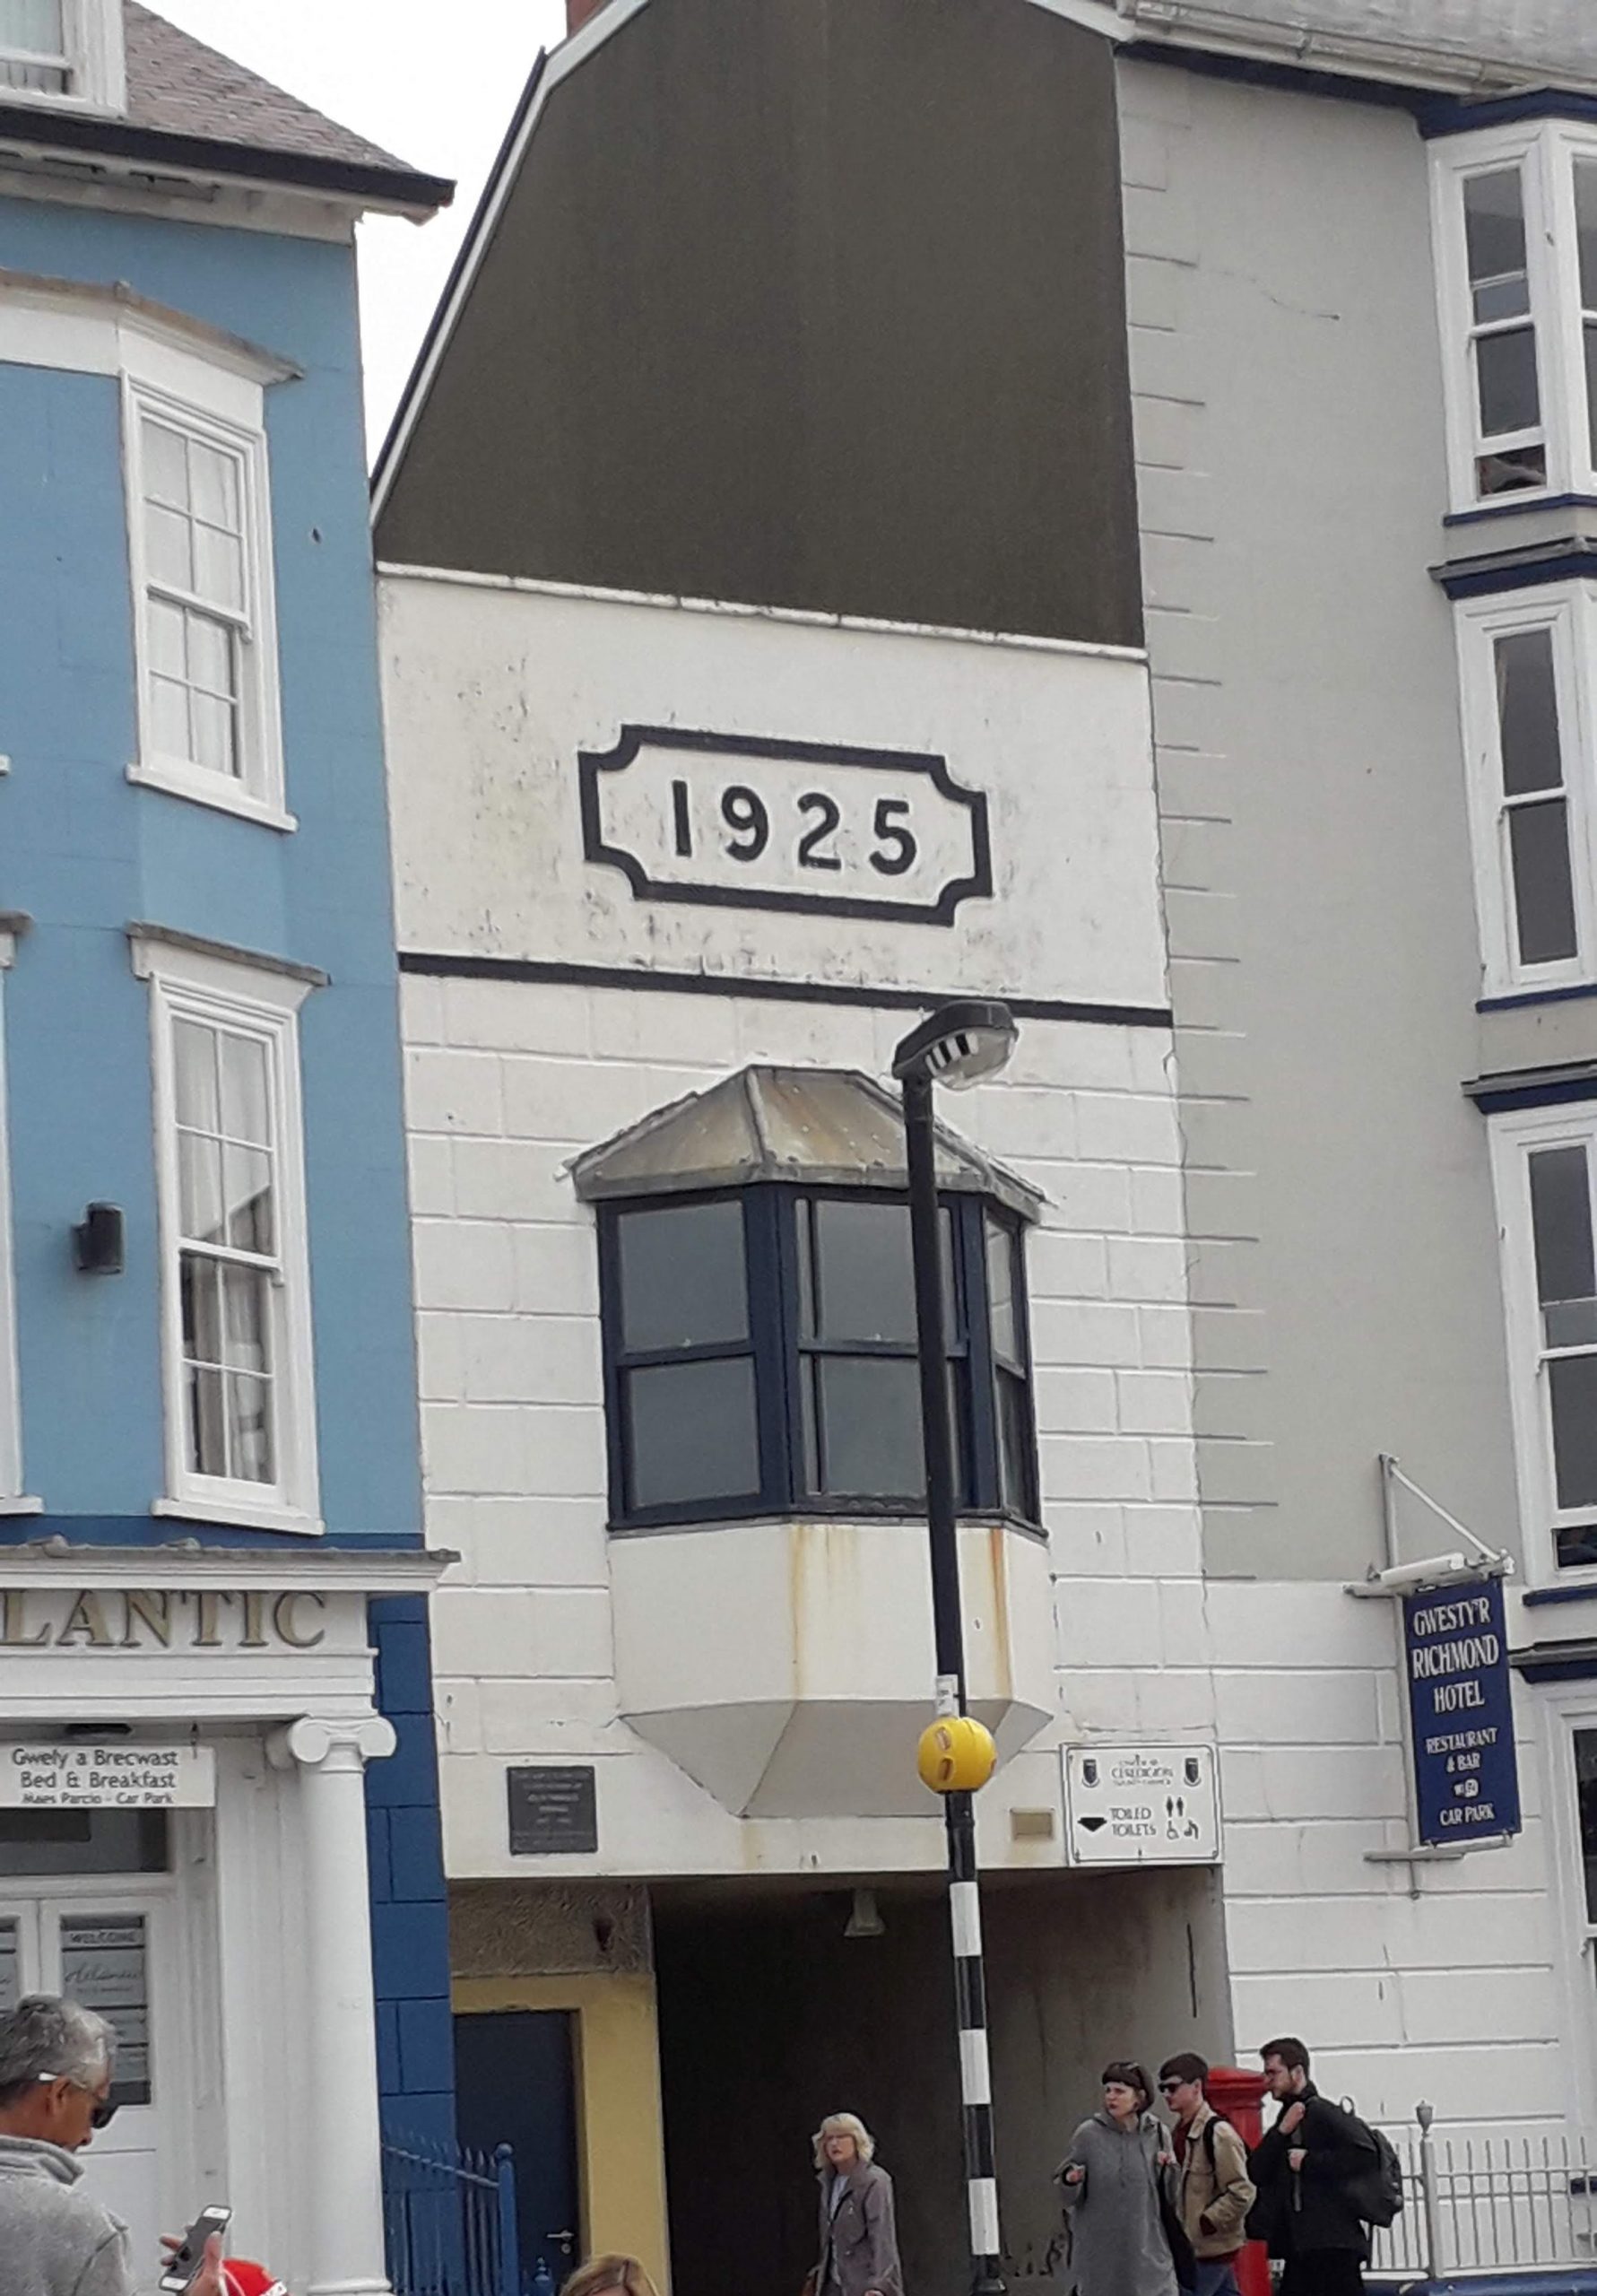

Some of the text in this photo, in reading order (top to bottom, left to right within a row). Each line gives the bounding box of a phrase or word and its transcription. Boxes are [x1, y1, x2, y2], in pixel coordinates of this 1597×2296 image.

[672, 779, 917, 876] 1925
[1413, 1597, 1490, 1636] GWESTY'R
[1412, 1634, 1499, 1679] RICHMOND
[1435, 1680, 1485, 1713] HOTEL
[1425, 1726, 1497, 1754] RESTAURANT
[76, 1753, 87, 1766] a
[93, 1750, 179, 1767] Brecwast
[1446, 1752, 1480, 1773] & BAR
[21, 1771, 176, 1788] Bed & Breakfast
[116, 1793, 139, 1805] Car
[143, 1793, 174, 1805] Park
[1439, 1803, 1495, 1826] CAR PARK
[1111, 1823, 1157, 1838] TOILETS
